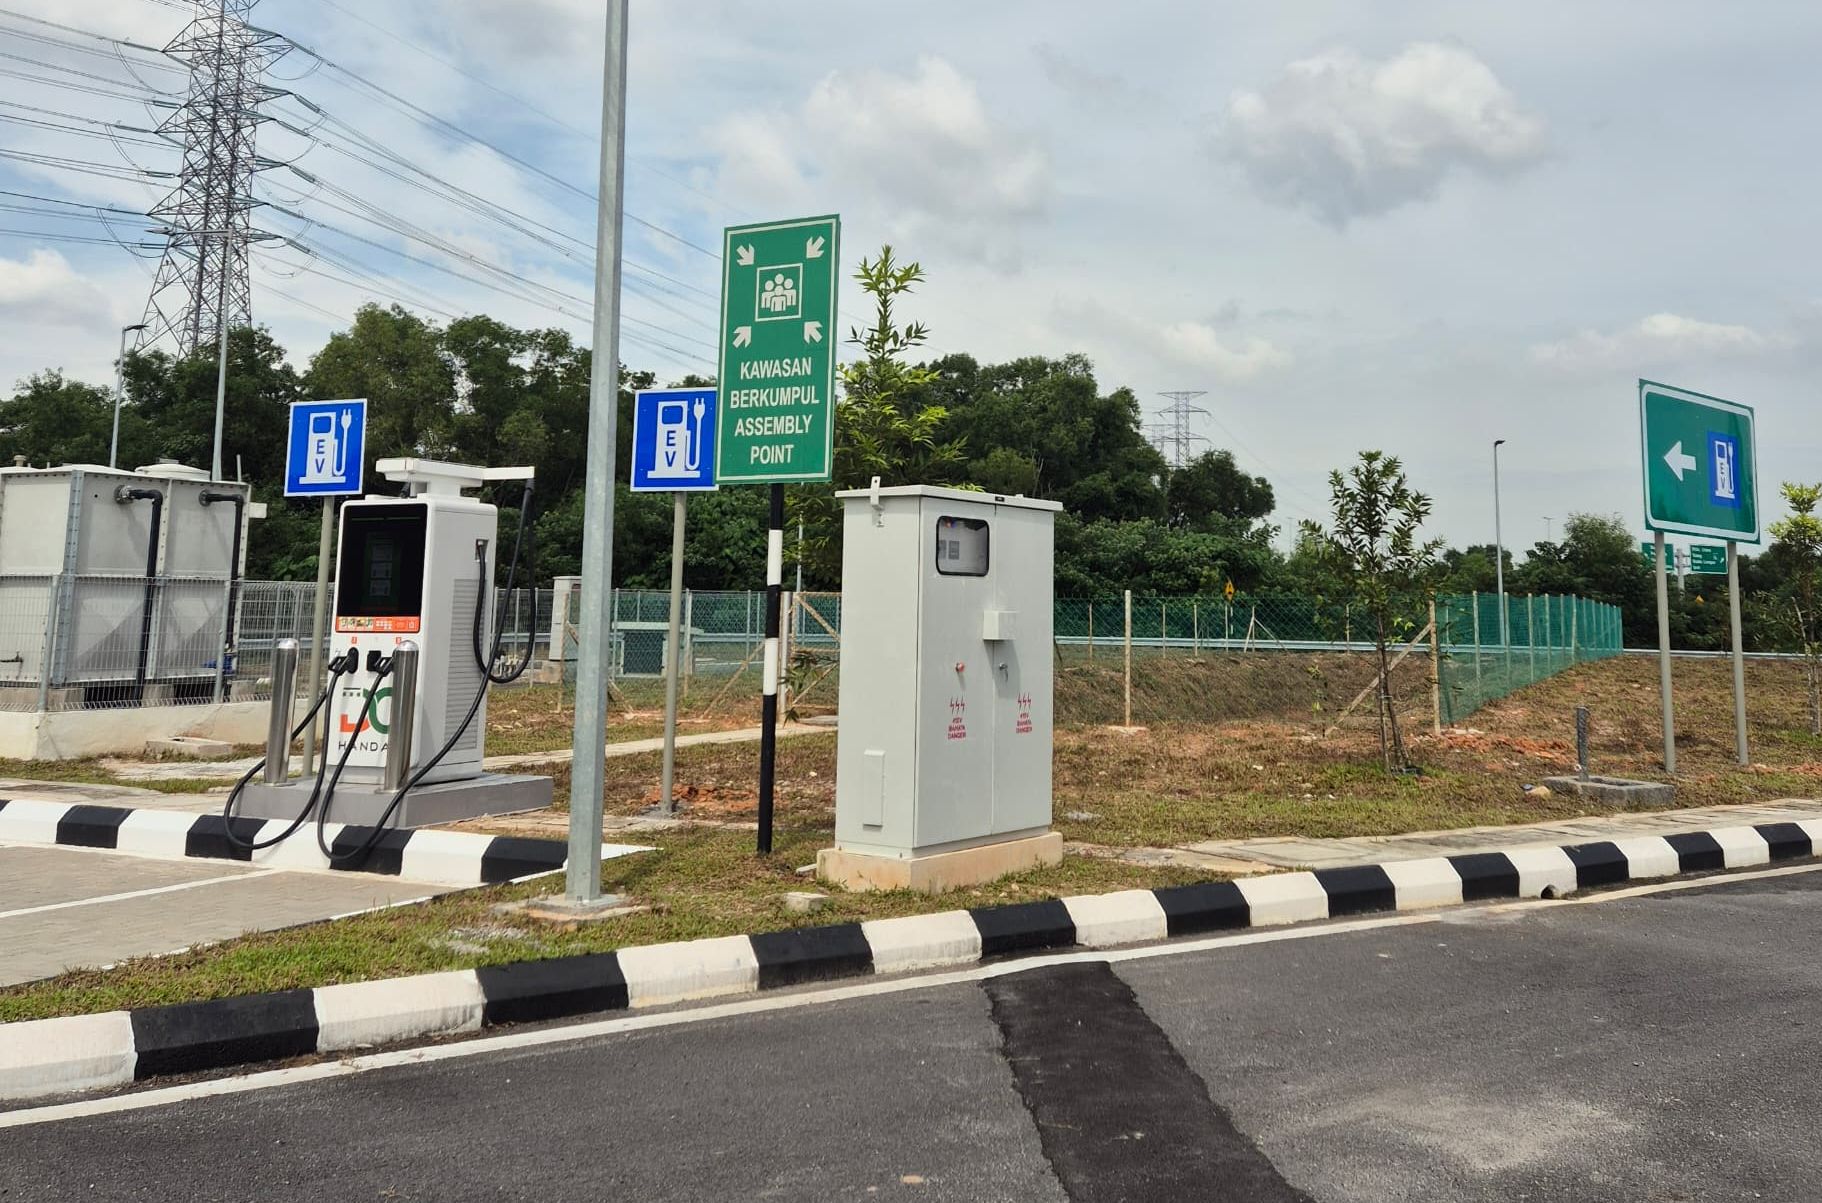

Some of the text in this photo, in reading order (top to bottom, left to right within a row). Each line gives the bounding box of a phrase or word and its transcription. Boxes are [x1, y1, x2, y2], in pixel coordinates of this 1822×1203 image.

[740, 357, 812, 380] KAWASAN
[730, 386, 820, 409] BERKUMPUL
[734, 414, 813, 437] ASSEMBLY
[750, 444, 794, 465] POINT
